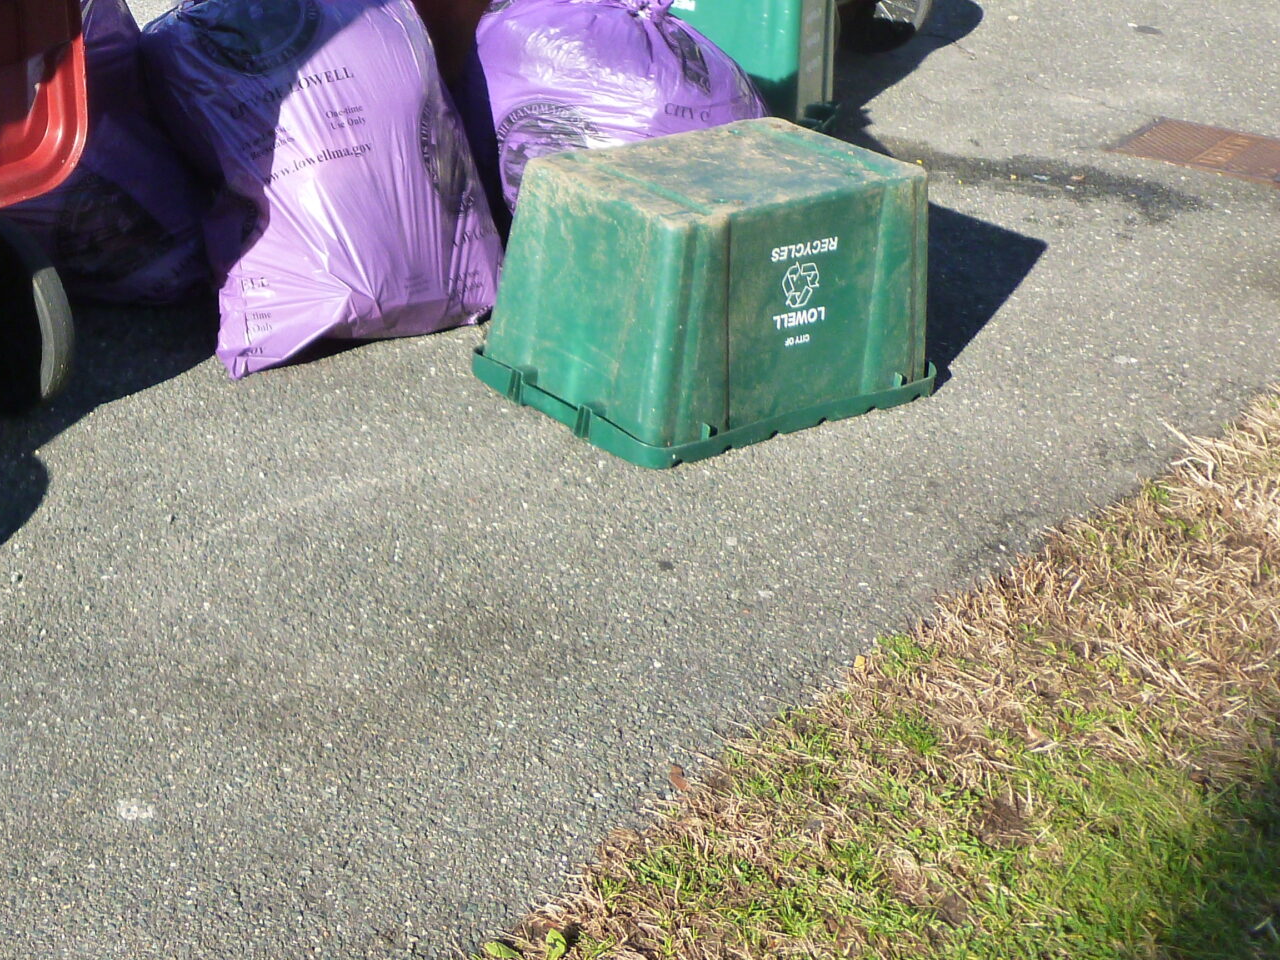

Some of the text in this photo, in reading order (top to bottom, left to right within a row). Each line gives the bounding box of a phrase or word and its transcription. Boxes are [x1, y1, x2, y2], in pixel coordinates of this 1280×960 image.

[288, 67, 355, 93] LOWELL
[346, 116, 367, 129] Only
[664, 102, 694, 120] CITY
[264, 142, 374, 185] www.lowellma.gov
[771, 236, 838, 263] RECYCLES
[772, 306, 826, 330] LOWELL
[784, 333, 810, 347] CITY OF
